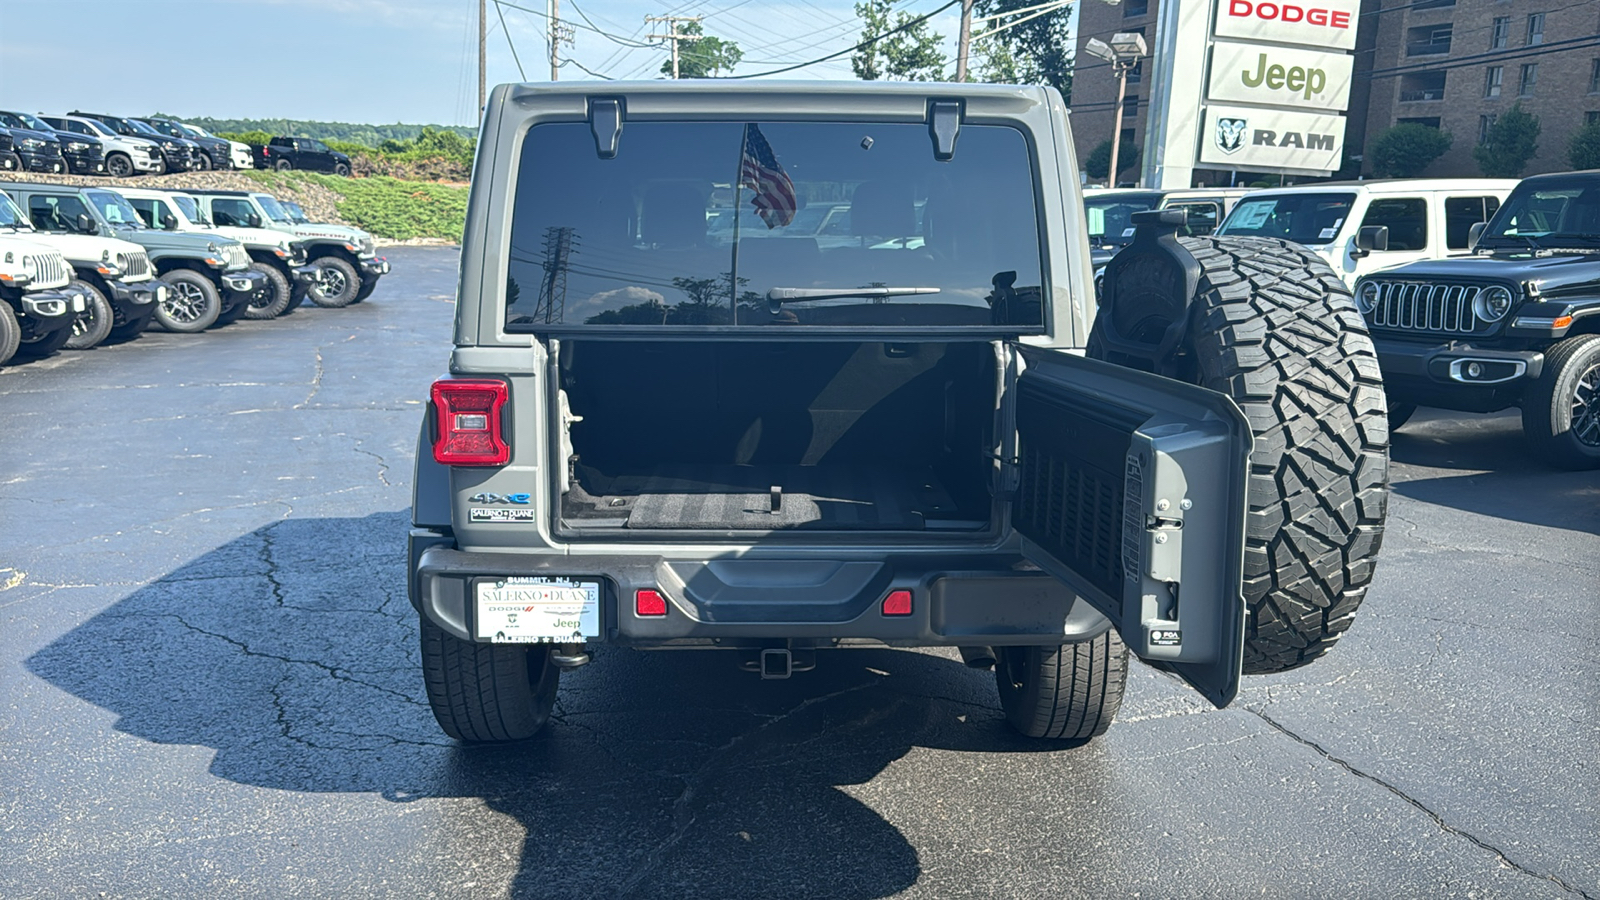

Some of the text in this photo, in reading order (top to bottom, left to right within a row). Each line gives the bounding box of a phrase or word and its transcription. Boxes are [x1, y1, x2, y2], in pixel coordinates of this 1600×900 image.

[1229, 0, 1350, 29] DODGE
[1241, 53, 1326, 100] Jeep
[1252, 129, 1335, 151] RAM
[472, 509, 533, 517] SALERNO DUANE
[555, 576, 570, 584] NJ
[483, 590, 595, 601] SALERNO DUANE
[553, 618, 581, 629] Jeep
[491, 635, 588, 644] SALERNO DUANE
